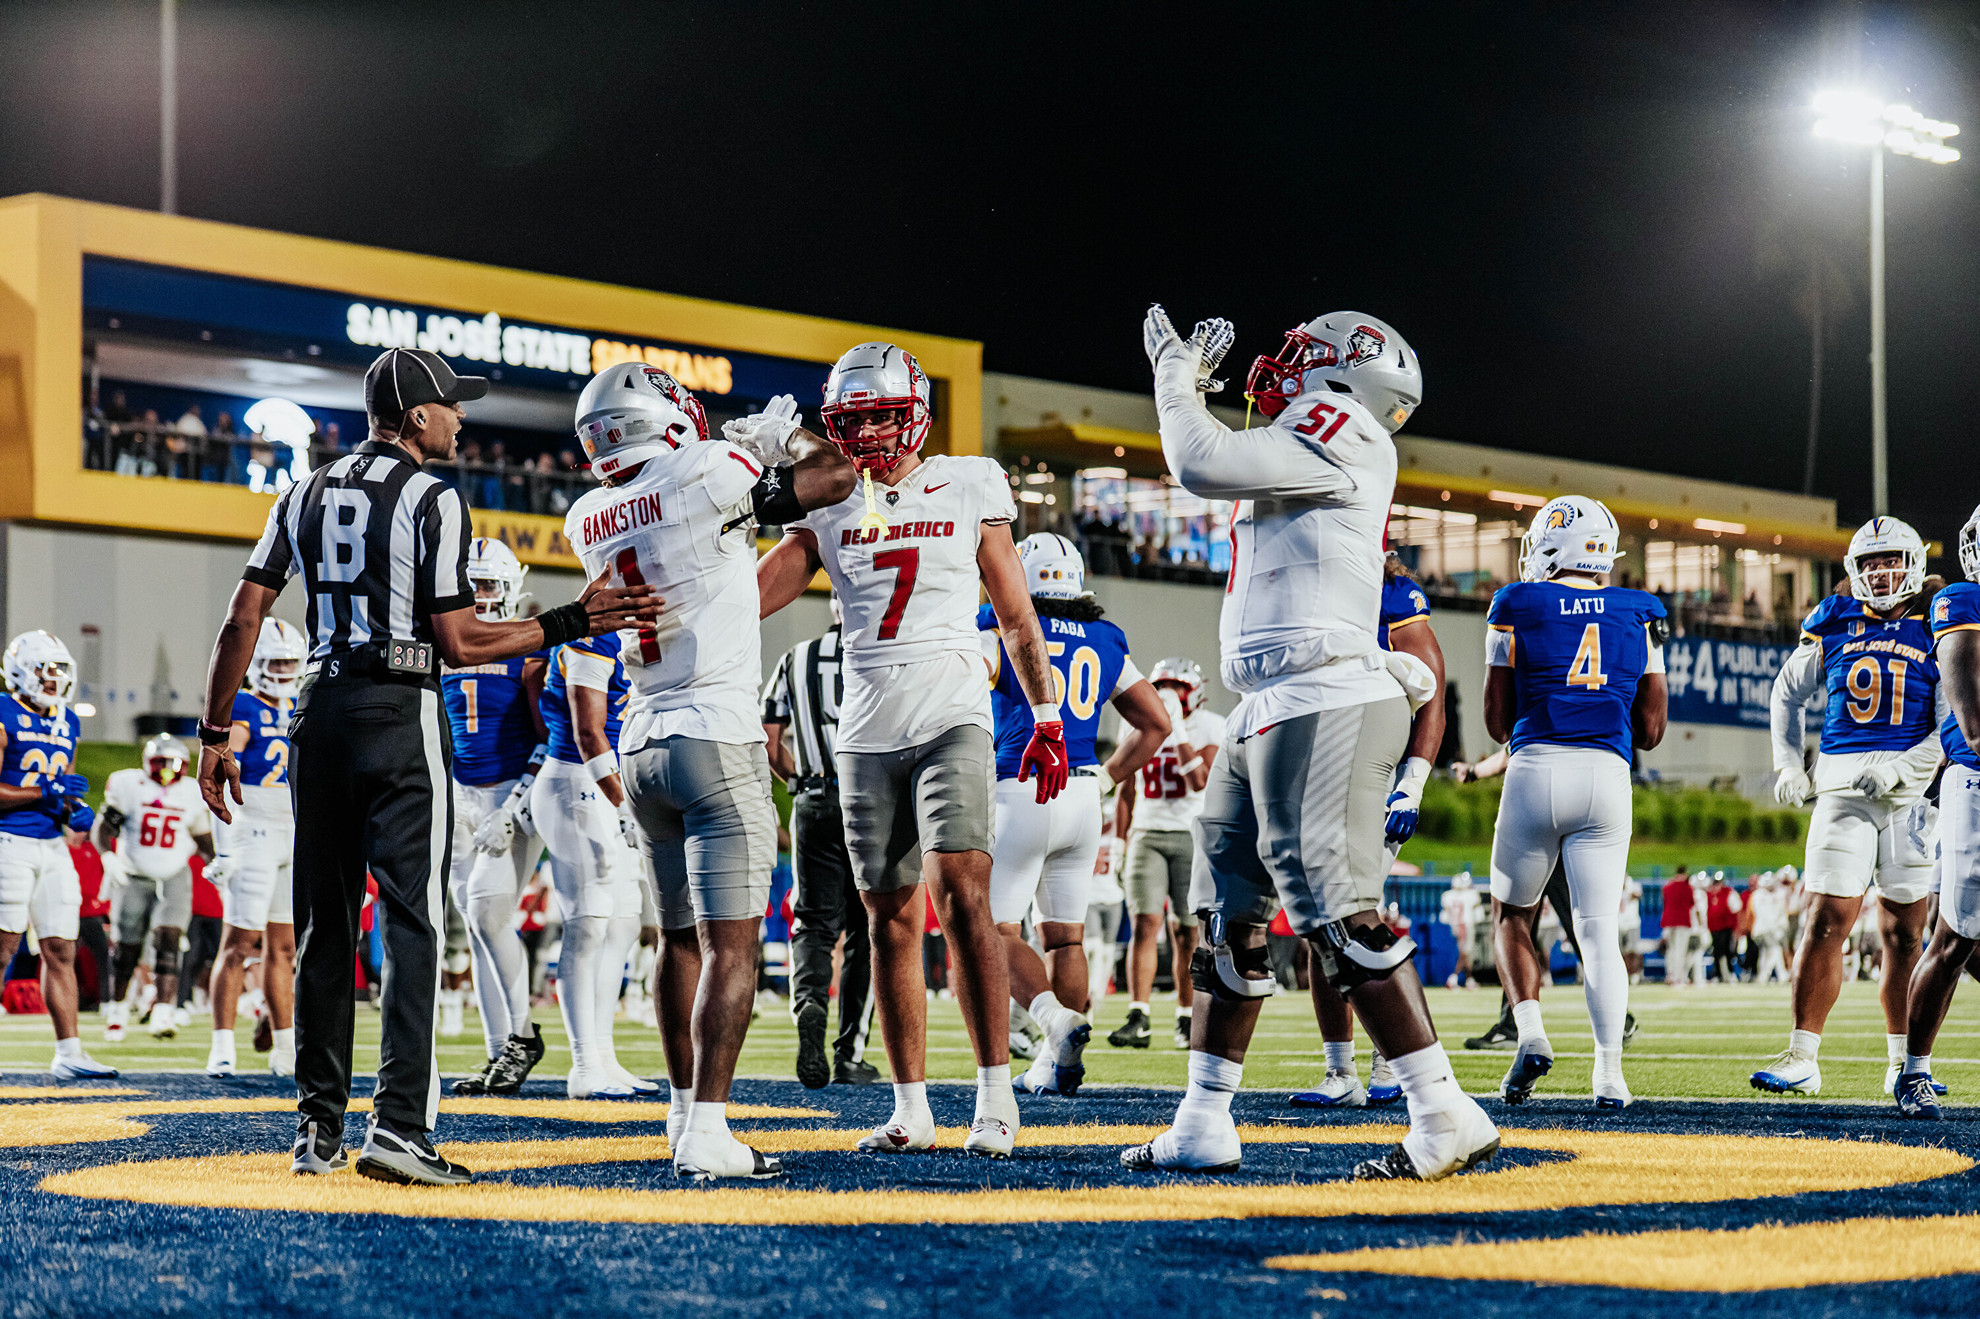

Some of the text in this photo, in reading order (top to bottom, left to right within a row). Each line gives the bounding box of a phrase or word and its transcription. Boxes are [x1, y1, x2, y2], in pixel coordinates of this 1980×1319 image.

[346, 303, 418, 348] SAN
[417, 311, 501, 363] JOSÉ
[502, 325, 591, 375] STATE
[1294, 402, 1351, 444] 51
[600, 457, 620, 473] GRIT
[317, 487, 371, 583] B
[583, 492, 663, 546] BANKSTON
[1576, 562, 1593, 570] SAN
[616, 545, 662, 668] 1
[873, 546, 920, 641] 7
[1559, 597, 1605, 615] LATU
[1050, 618, 1087, 638] FAGA
[329, 660, 340, 678] S
[478, 663, 508, 676] STATE
[1566, 623, 1608, 691] 4
[1667, 640, 1718, 704] #4
[1843, 639, 1928, 664] SAN JOSÉ STATE
[1047, 641, 1101, 721] 50
[1720, 677, 1739, 706] IN
[1846, 655, 1908, 727] 91
[460, 678, 479, 734] 1
[1142, 756, 1186, 799] 85
[139, 812, 181, 849] 66
